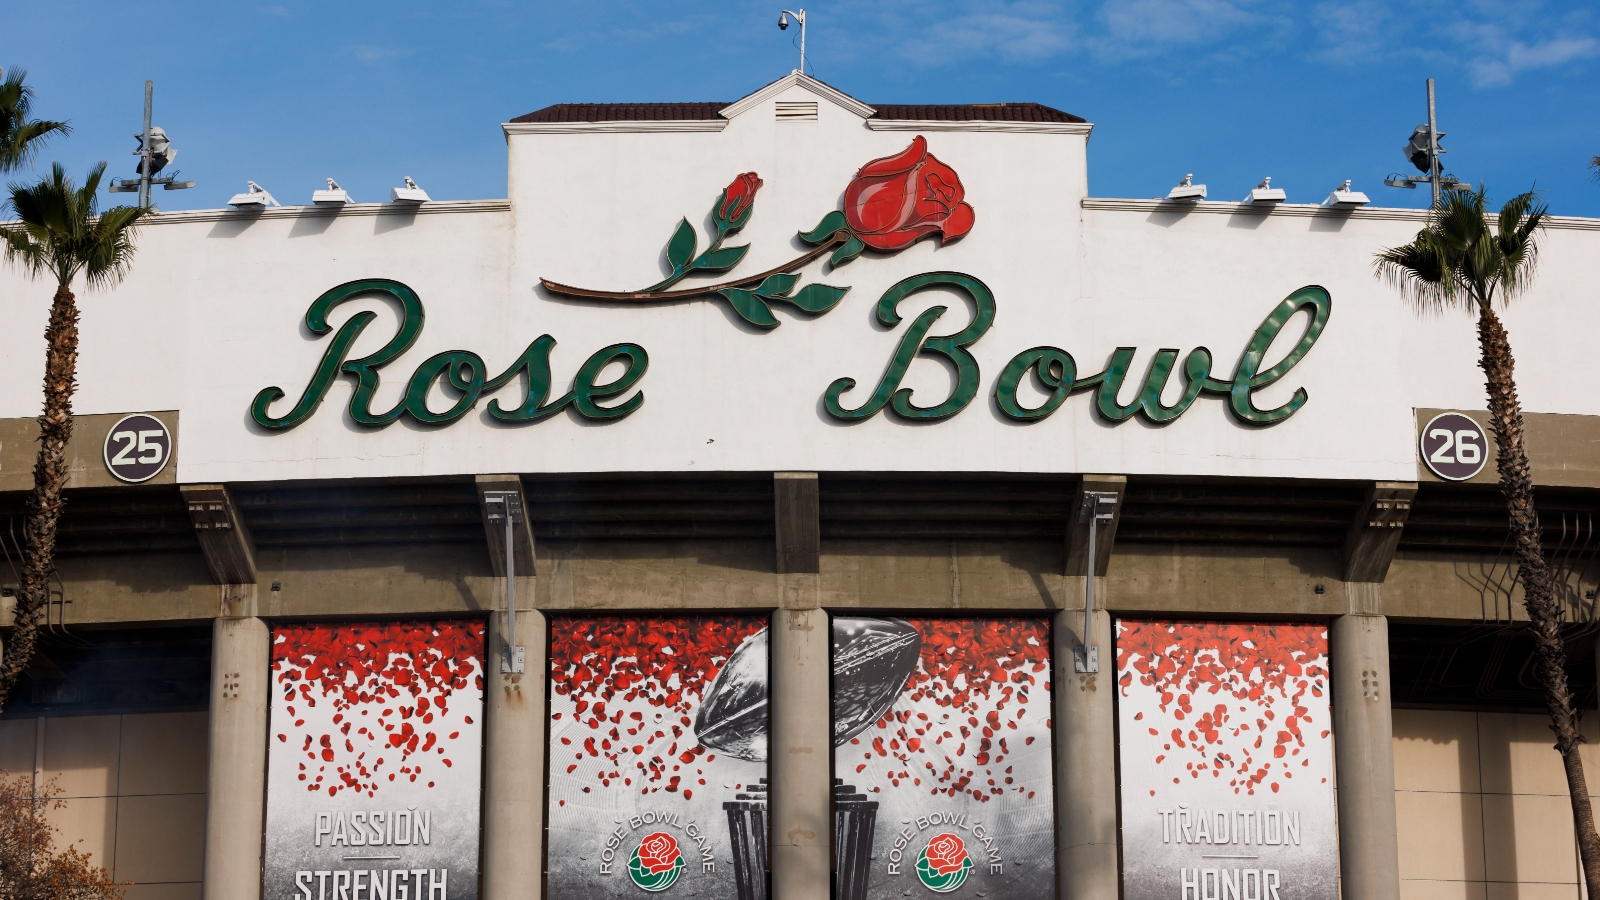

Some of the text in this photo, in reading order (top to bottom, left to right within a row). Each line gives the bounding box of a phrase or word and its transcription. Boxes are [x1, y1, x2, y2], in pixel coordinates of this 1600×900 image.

[251, 271, 1332, 431] Rose Bowl
[111, 429, 164, 466] 25
[1429, 428, 1481, 464] 26
[314, 810, 431, 846] PASSION
[600, 810, 715, 875] ROSE BOWL GAME
[888, 811, 1003, 875] ROSE BOWL GAME
[1158, 808, 1300, 845] TRADITION
[294, 869, 448, 900] STRENGTH
[1180, 867, 1281, 900] HONOR
